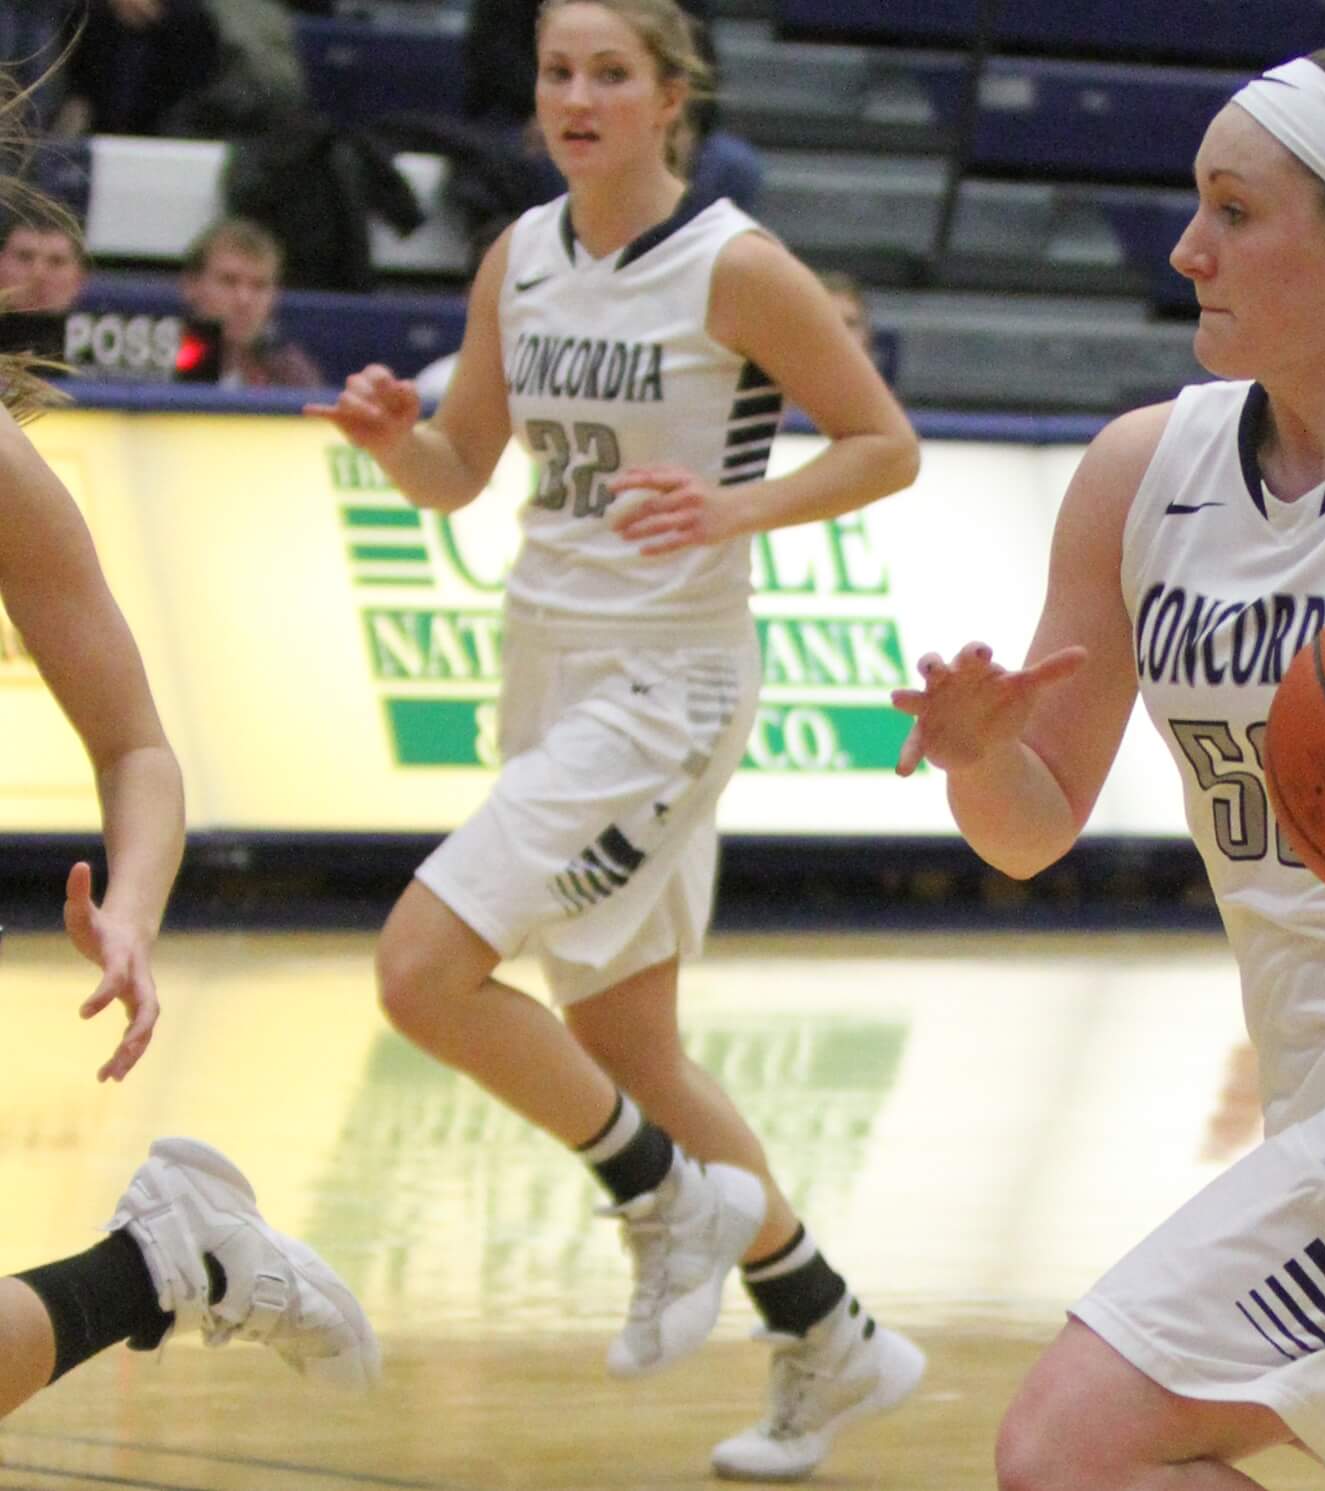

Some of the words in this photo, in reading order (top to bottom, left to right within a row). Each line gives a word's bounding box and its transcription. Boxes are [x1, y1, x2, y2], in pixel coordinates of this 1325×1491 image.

[64, 313, 182, 367] POSS
[525, 419, 622, 518] 32
[766, 619, 906, 688] ANK
[1168, 718, 1306, 870] 5
